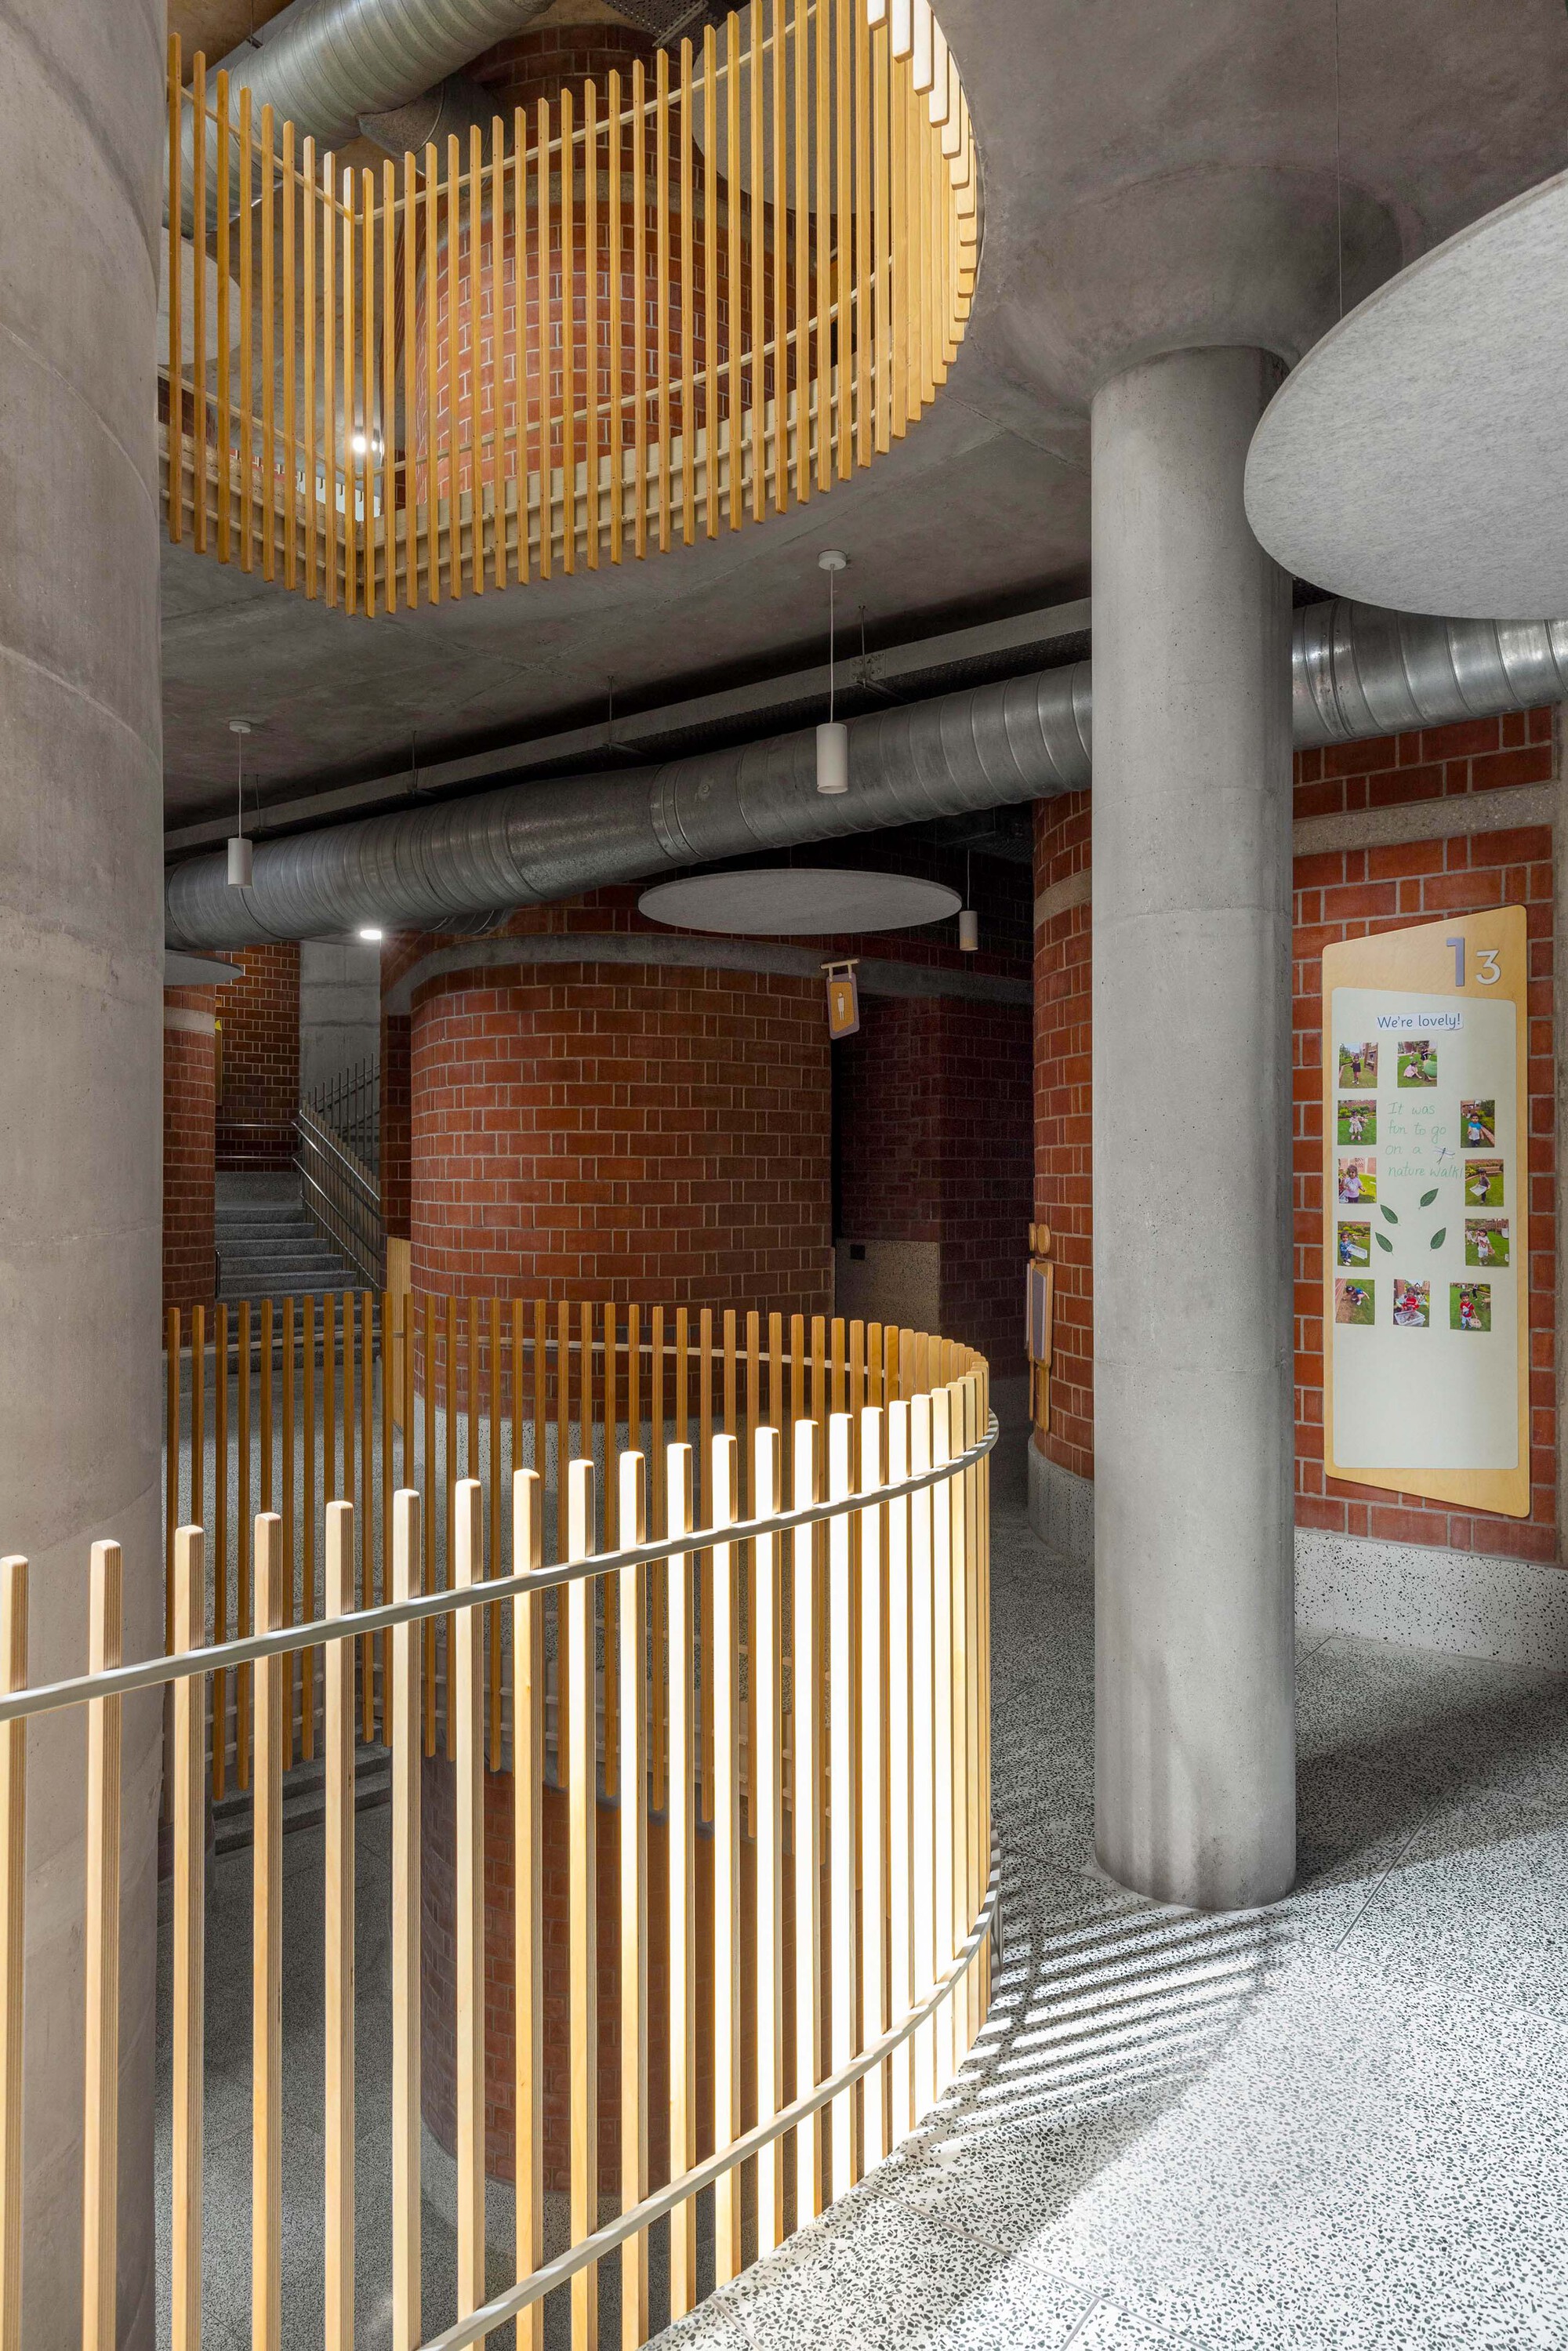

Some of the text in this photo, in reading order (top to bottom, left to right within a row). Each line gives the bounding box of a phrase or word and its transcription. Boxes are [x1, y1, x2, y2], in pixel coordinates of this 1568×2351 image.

[1377, 1012, 1461, 1030] We're lovely!
[1387, 1101, 1436, 1115] It was
[1388, 1119, 1446, 1145] fun to go
[1385, 1145, 1423, 1156] on a
[1388, 1161, 1425, 1177] nature
